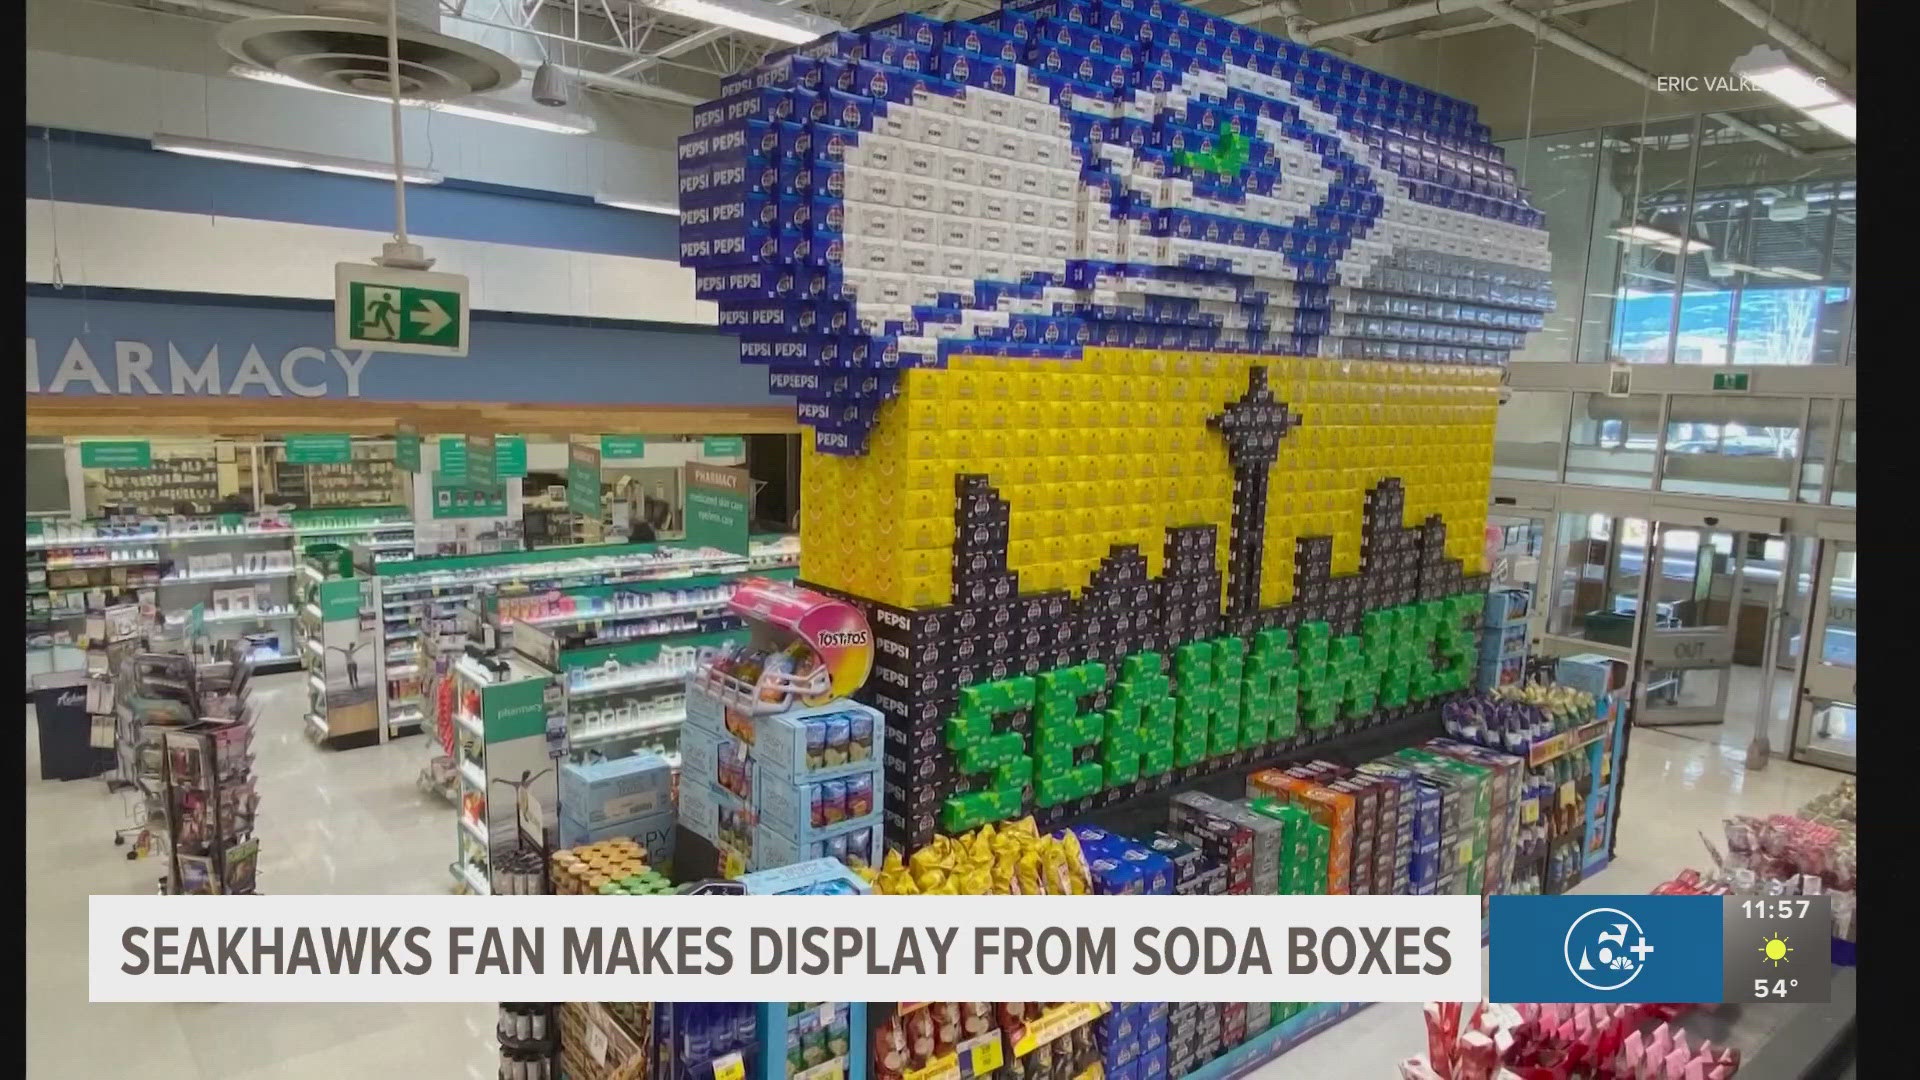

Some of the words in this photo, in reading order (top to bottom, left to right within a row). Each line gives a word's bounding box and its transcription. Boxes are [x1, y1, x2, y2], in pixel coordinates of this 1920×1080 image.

[722, 79, 752, 98] PEPSI
[757, 66, 789, 88] PEPSI
[695, 108, 724, 128] PEPSI
[728, 97, 760, 120] PEPSI
[679, 139, 709, 160] PEPSI
[712, 131, 745, 152] PEPSI
[680, 173, 709, 193] PEPSI
[713, 167, 745, 187] PEPSI
[680, 207, 709, 226] PEPSI
[713, 202, 744, 221] PEPSI
[681, 240, 710, 257] PEPSI
[714, 236, 745, 254] PEPSI
[697, 275, 726, 292] PEPSI
[730, 273, 761, 290] PEPSI
[720, 311, 749, 325] PEPSI
[752, 309, 784, 324] PEPSI
[741, 343, 771, 357] PEPSI
[774, 343, 807, 357] PEPSI
[26, 337, 373, 397] ARMACY
[795, 375, 819, 388] EPSI
[798, 403, 830, 418] PEPSI
[817, 431, 848, 448] PEPSI
[695, 470, 737, 488] PHARMACY
[876, 609, 911, 631] PEPSI
[876, 637, 910, 660] PEPSI
[1674, 642, 1704, 659] OUT
[876, 665, 909, 688] PEPSI
[498, 704, 543, 720] pharmacy
[876, 693, 908, 717] PEPSI
[942, 593, 1485, 833] SEAHAWKS
